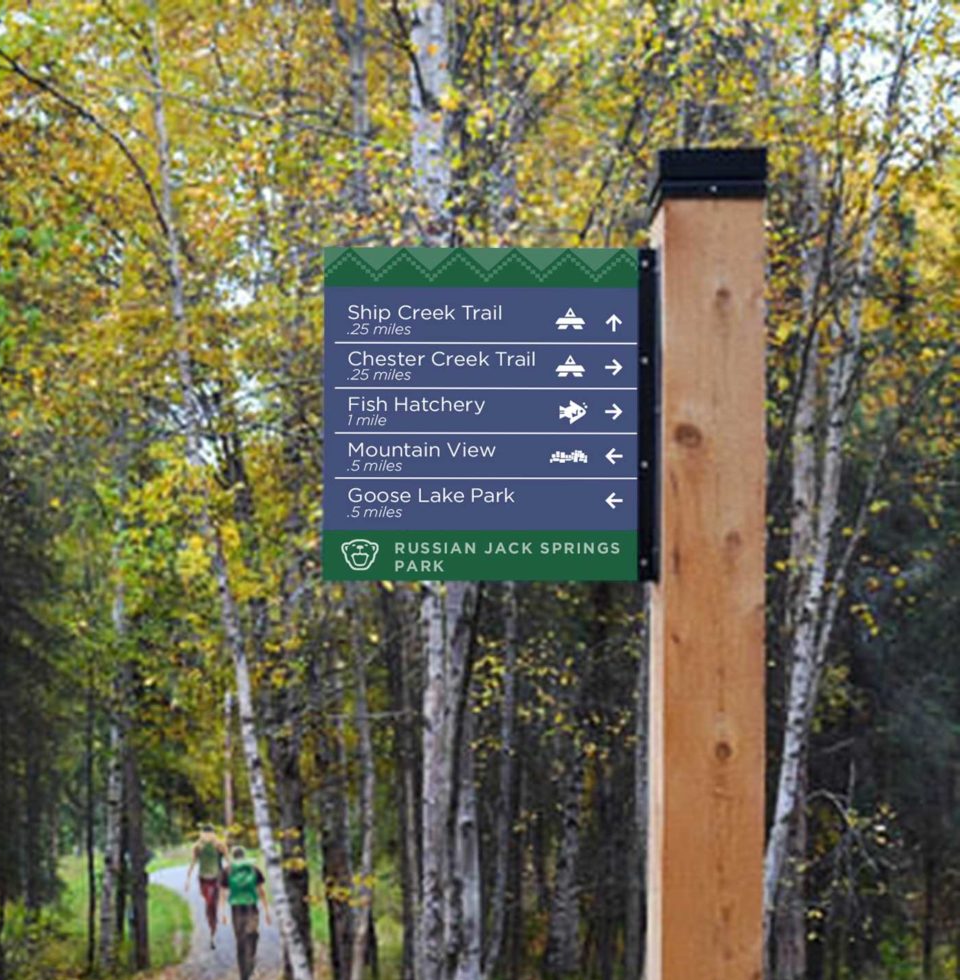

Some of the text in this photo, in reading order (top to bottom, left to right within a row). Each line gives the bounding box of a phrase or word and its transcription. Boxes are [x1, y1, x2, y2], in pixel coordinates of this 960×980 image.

[348, 305, 501, 322] Ship Creek Trail
[347, 323, 411, 335] .25 miles
[348, 351, 535, 366] Chester Creek Trail
[347, 369, 411, 380] .25 miles
[349, 396, 485, 415] Fish Hatchery
[347, 415, 386, 426] 1 mile
[349, 442, 496, 457] Mountain View
[347, 460, 402, 471] .5 miles
[348, 488, 514, 502] Goose Lake Park
[347, 506, 402, 518] .5 miles
[395, 542, 619, 554] RUSSIAN JACK SPRINGS
[396, 560, 443, 571] PARK
